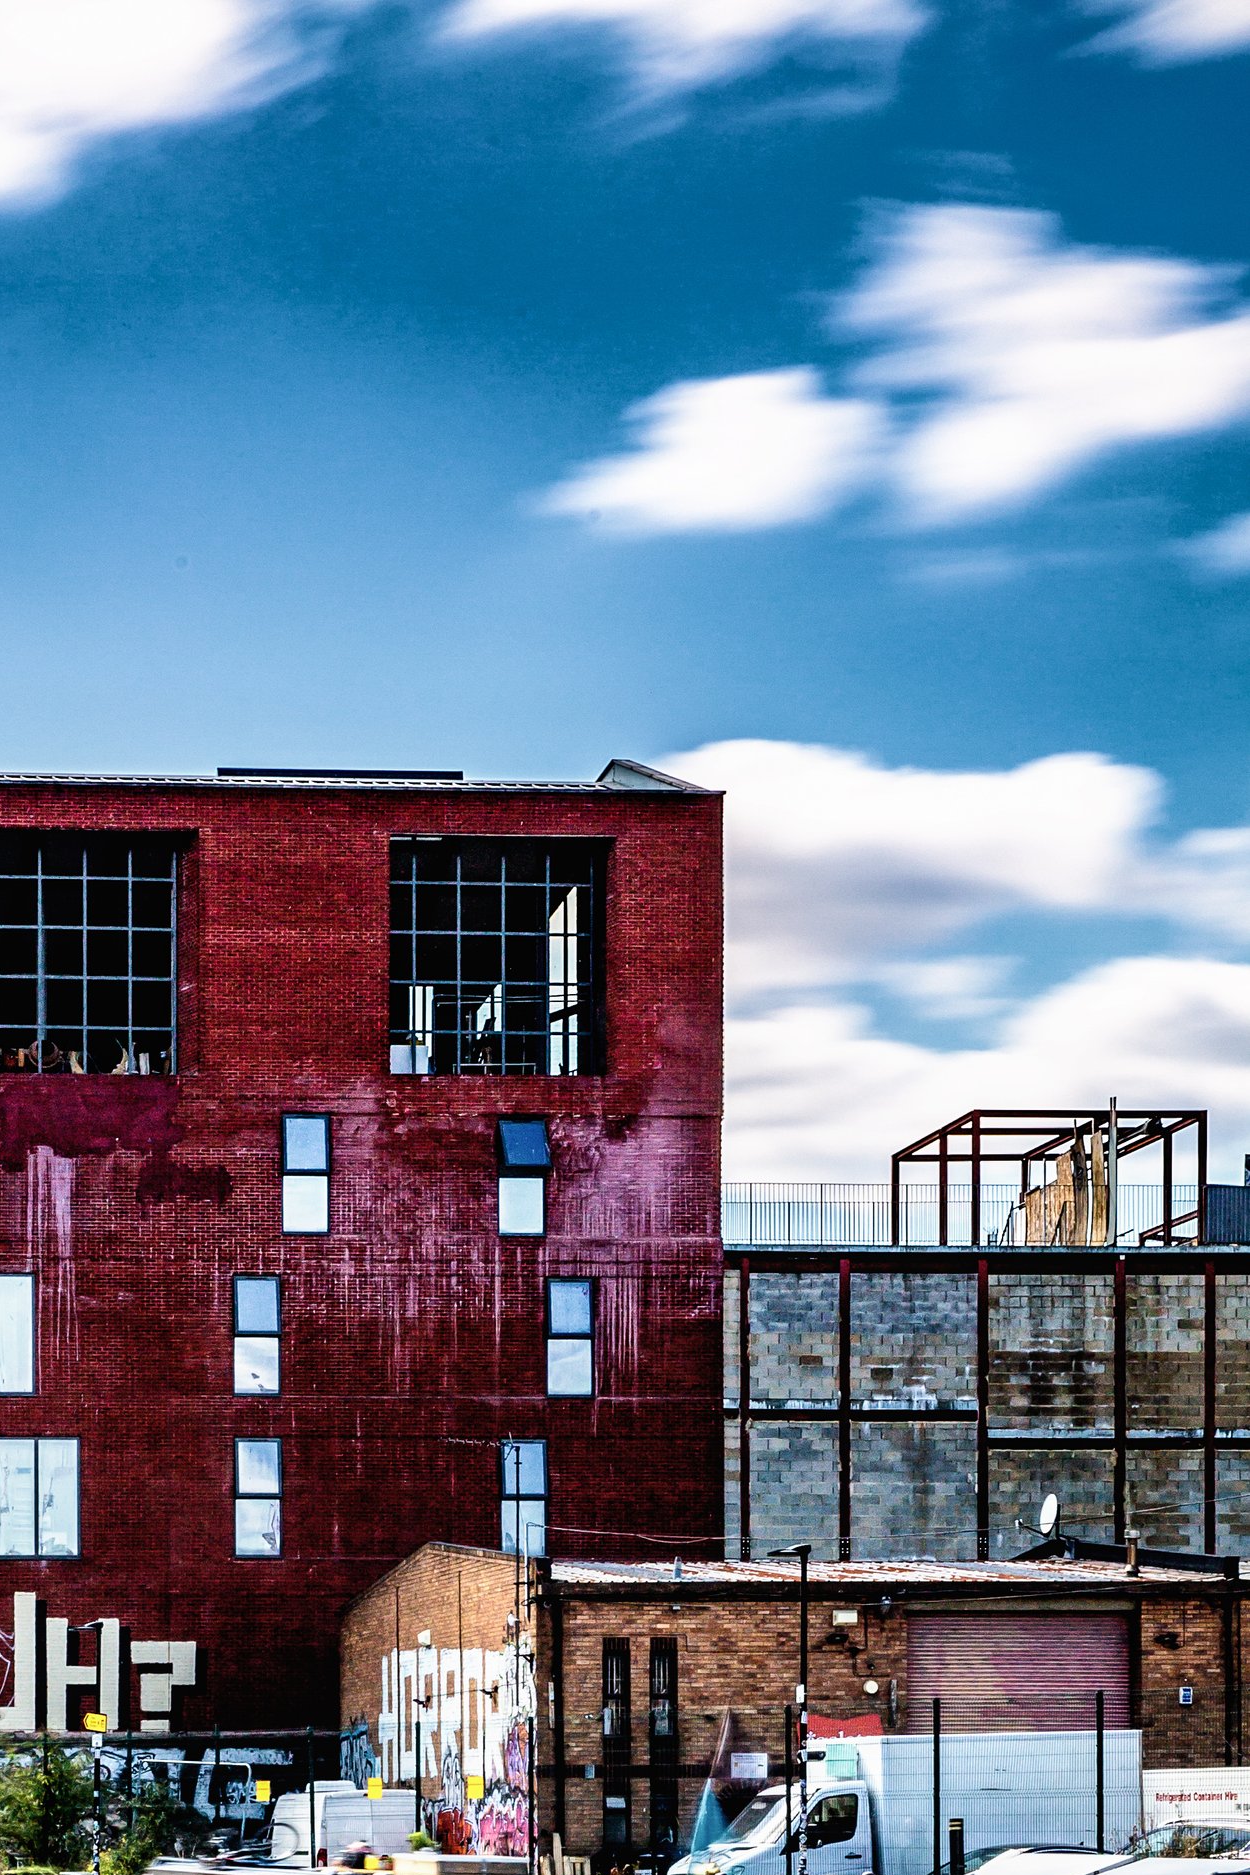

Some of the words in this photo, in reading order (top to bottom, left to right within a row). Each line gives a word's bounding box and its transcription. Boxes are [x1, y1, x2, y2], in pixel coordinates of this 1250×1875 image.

[1156, 1792, 1191, 1803] Refrigerated
[1193, 1791, 1223, 1801] Container
[1224, 1790, 1238, 1800] Hire
